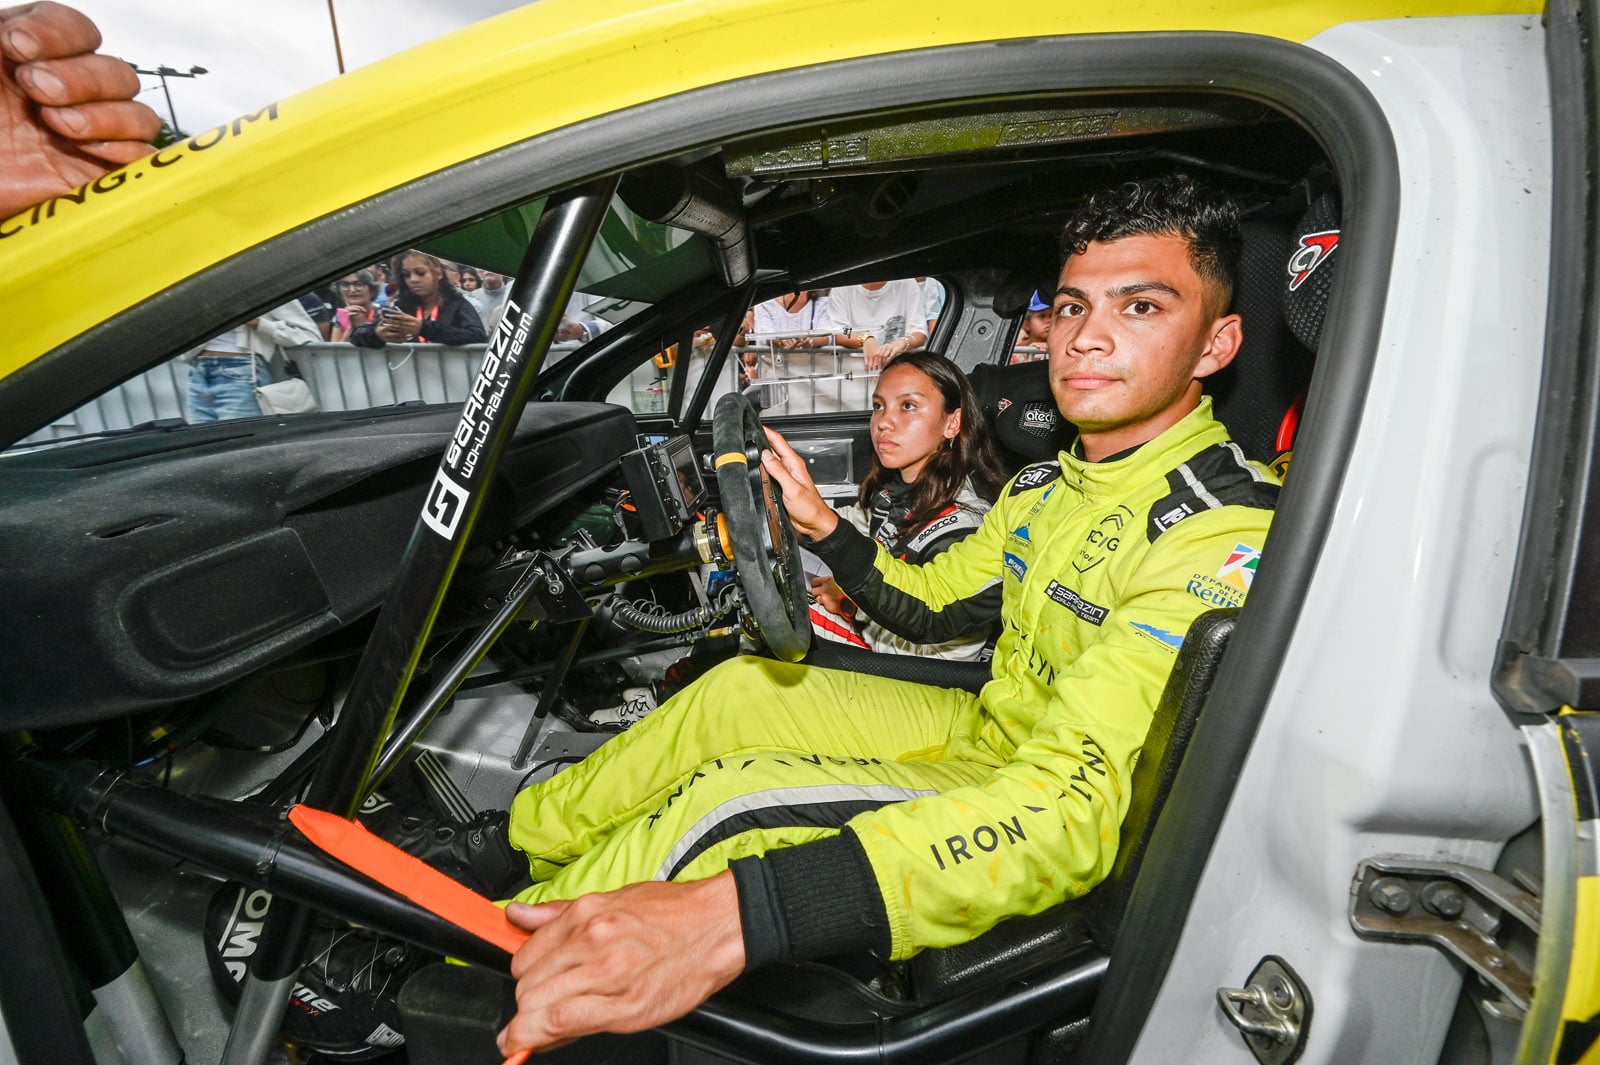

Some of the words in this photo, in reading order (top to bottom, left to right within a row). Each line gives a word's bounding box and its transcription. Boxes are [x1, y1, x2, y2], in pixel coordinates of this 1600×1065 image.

[446, 299, 521, 469] SARRAZIN
[460, 420, 490, 479] WORLD
[484, 372, 511, 421] RALLY
[505, 312, 533, 364] TEAM
[918, 515, 959, 544] sparco
[930, 815, 1028, 871] IRON
[292, 982, 341, 1013] ne
